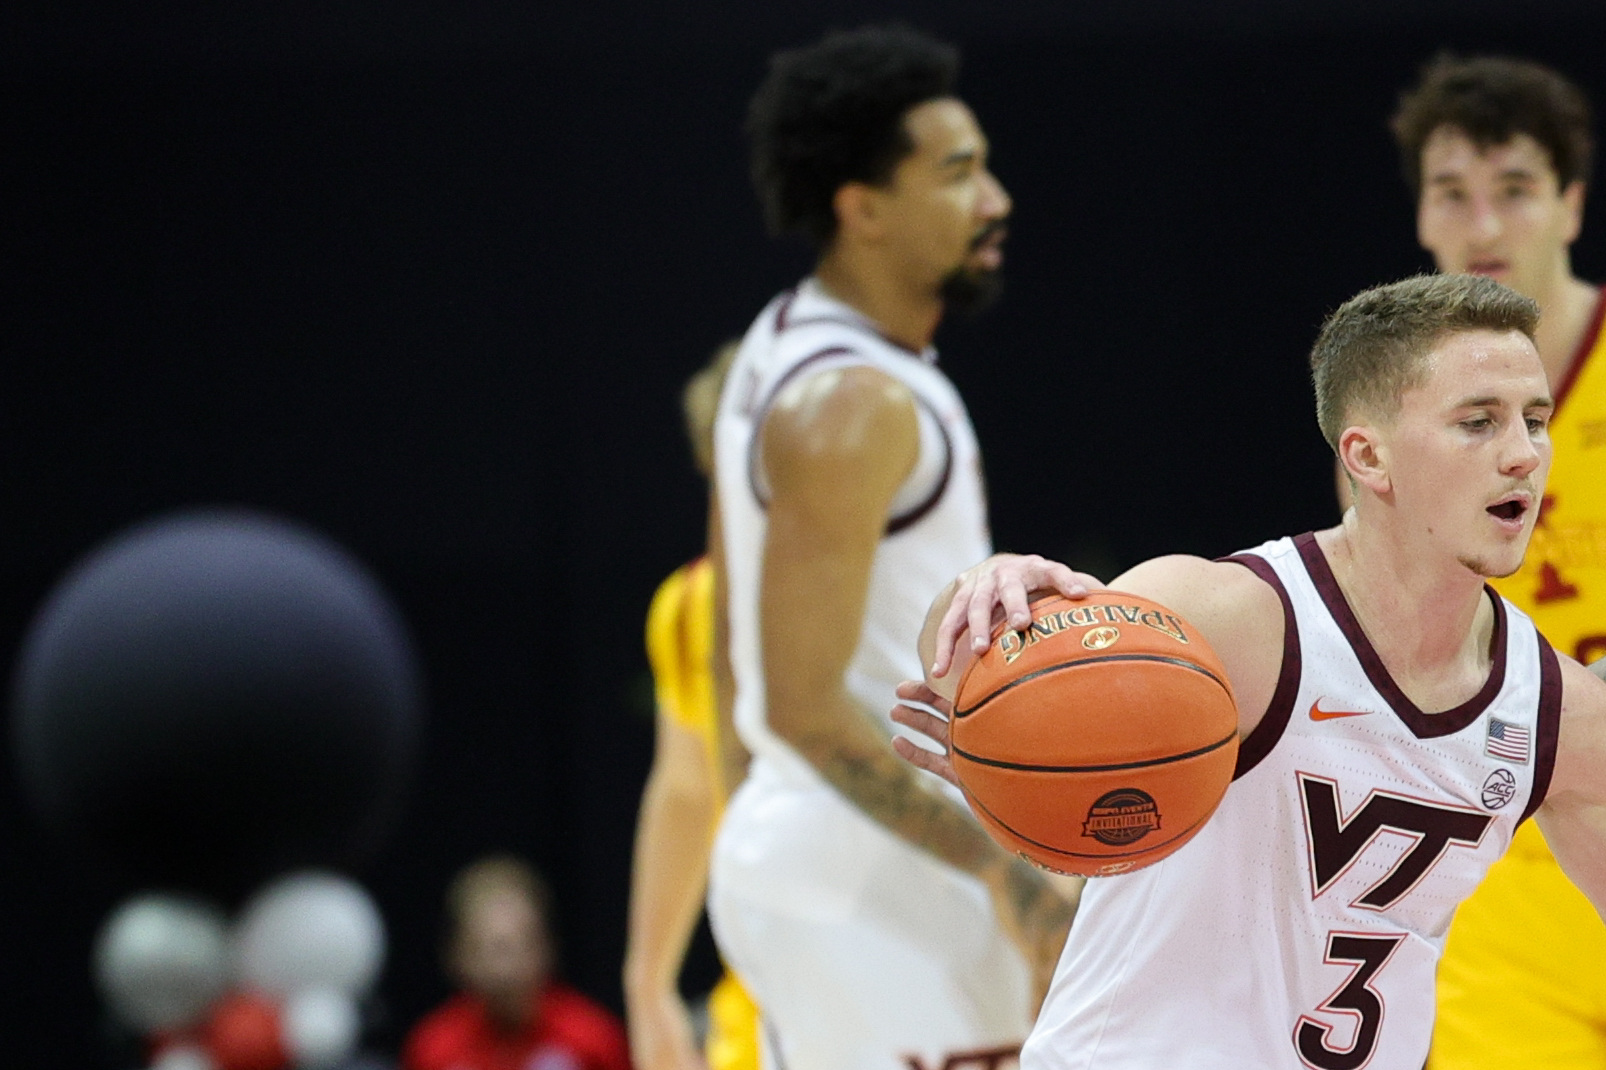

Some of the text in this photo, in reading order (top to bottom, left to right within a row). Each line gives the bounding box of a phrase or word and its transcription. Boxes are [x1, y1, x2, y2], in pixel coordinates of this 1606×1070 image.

[999, 604, 1190, 666] SPALDING
[1486, 782, 1516, 795] ACC
[1295, 770, 1497, 911] VT
